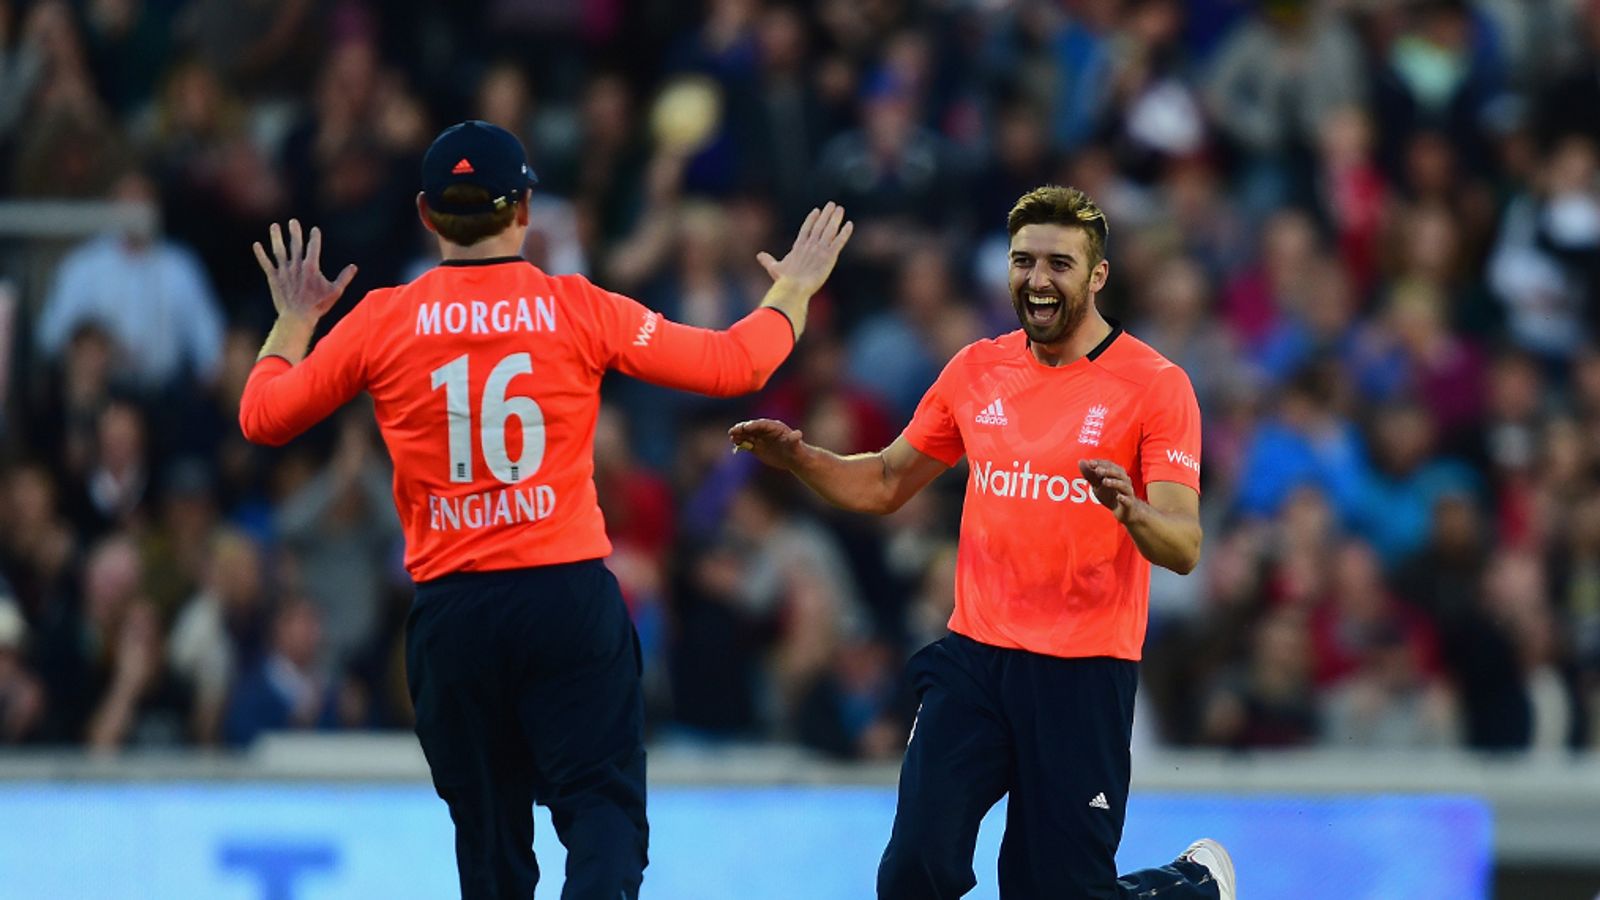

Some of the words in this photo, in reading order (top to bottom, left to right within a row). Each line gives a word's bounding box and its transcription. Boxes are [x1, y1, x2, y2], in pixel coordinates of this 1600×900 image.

[415, 295, 556, 336] MORGAN
[430, 351, 546, 484] 16
[975, 414, 1009, 427] adidas
[429, 484, 556, 531] ENGLAND
